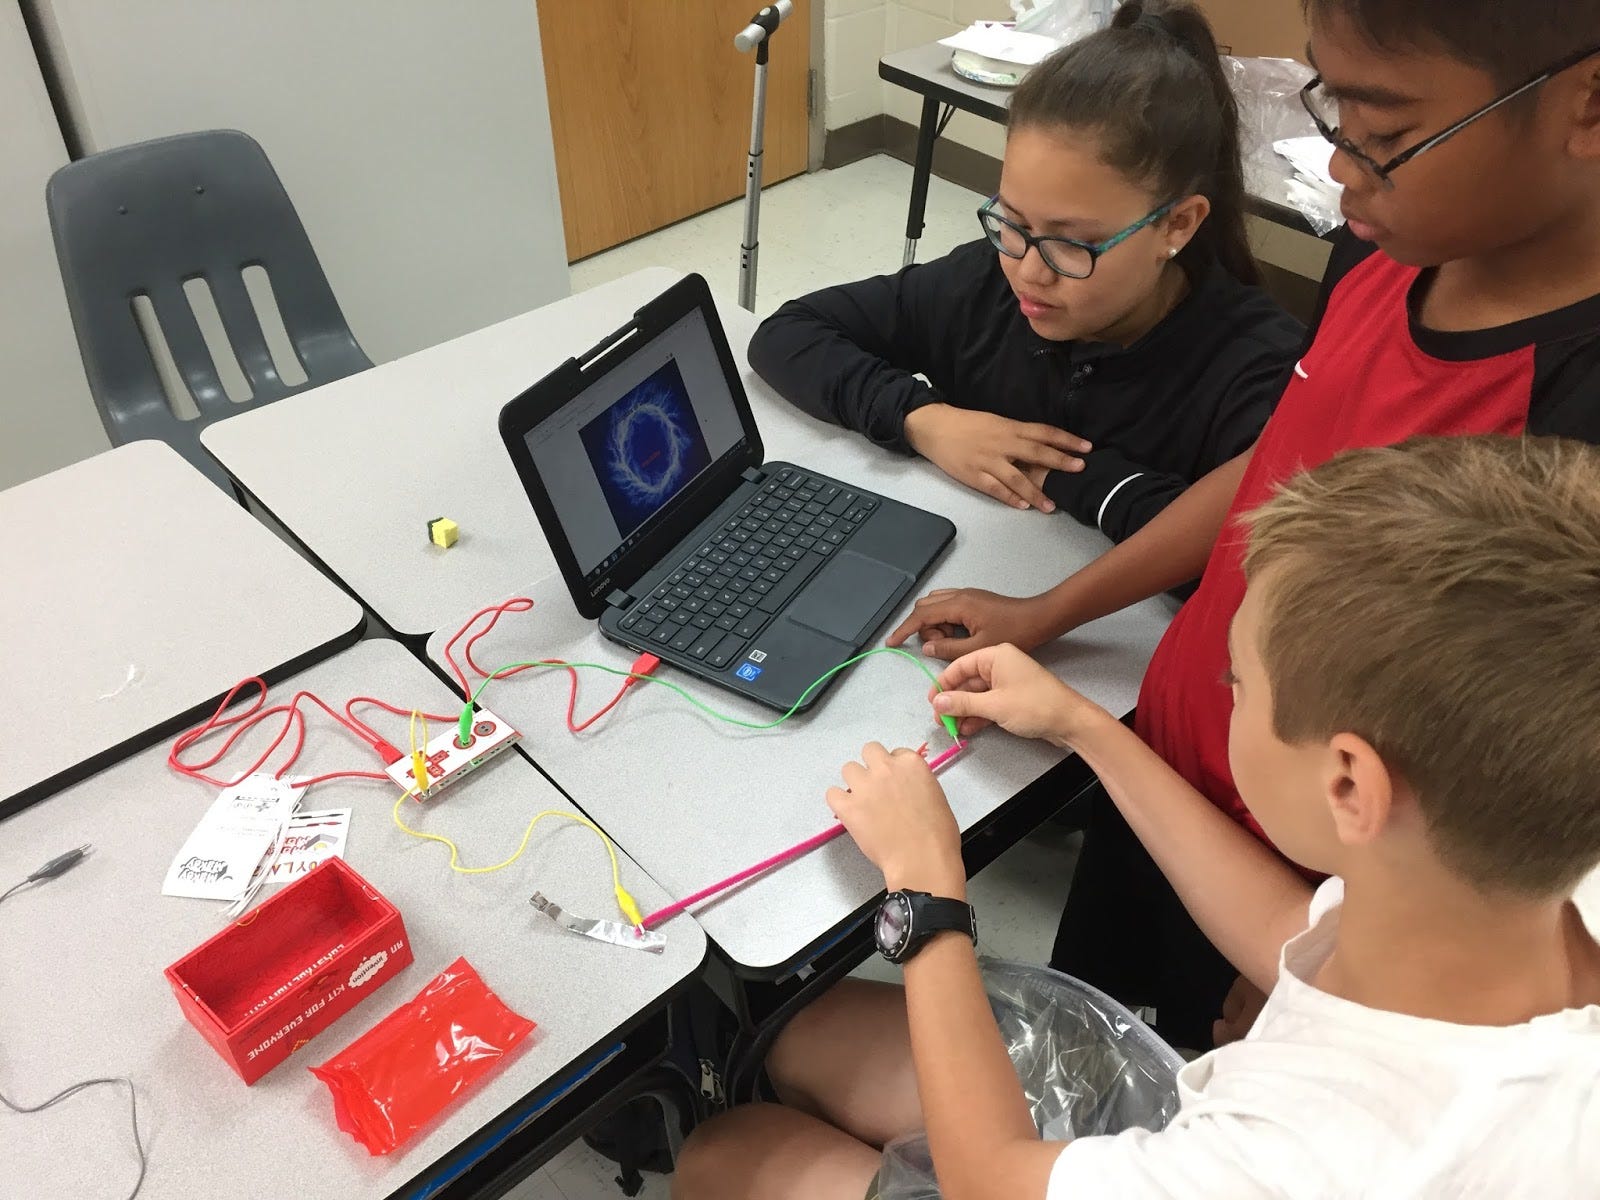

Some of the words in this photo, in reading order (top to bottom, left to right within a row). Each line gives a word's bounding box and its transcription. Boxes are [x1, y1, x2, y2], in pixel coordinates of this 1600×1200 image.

[590, 578, 610, 598] Lenovo
[390, 940, 404, 954] AN
[352, 955, 384, 983] invention
[327, 983, 346, 1003] KIT
[304, 999, 326, 1019] FOR
[247, 1015, 304, 1062] EVERYONE
